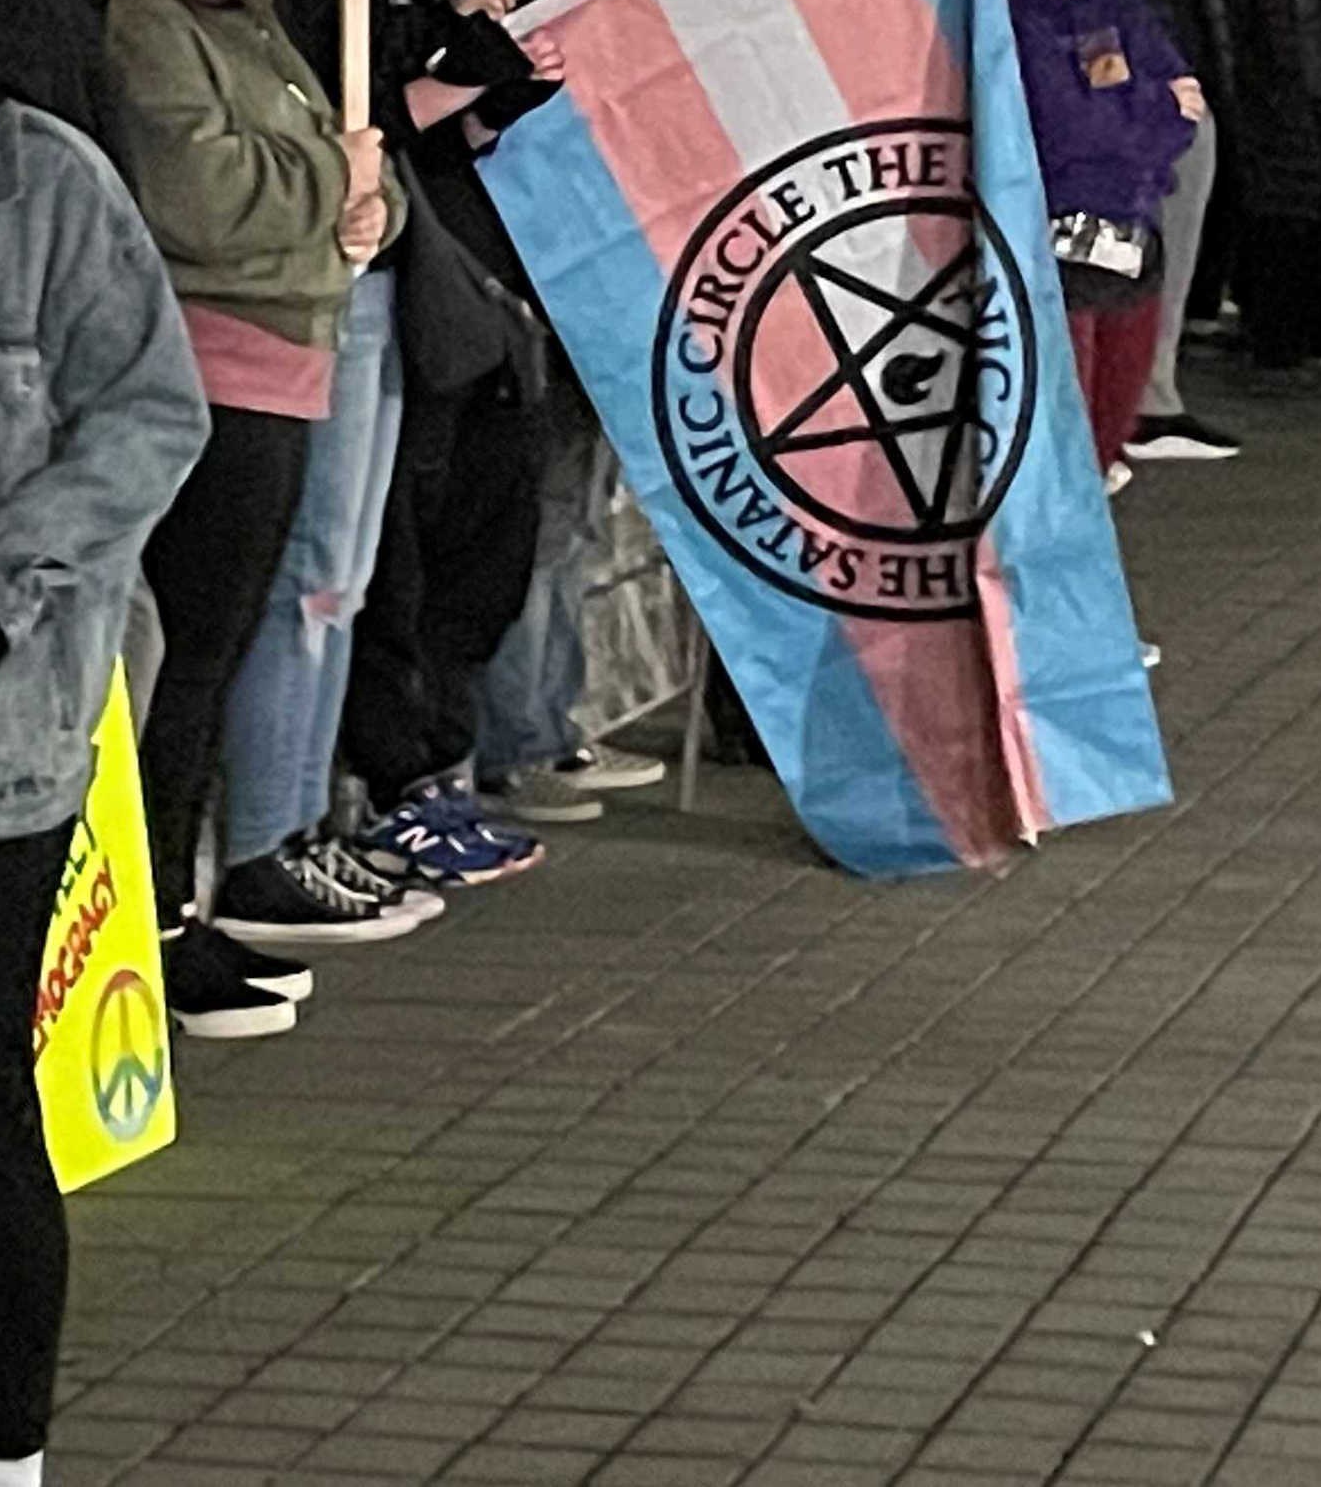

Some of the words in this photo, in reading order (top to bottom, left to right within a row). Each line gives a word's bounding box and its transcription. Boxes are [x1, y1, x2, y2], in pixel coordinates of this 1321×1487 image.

[679, 179, 818, 375] CIRCLE
[823, 141, 949, 203] THE
[679, 390, 866, 592] SATANIC
